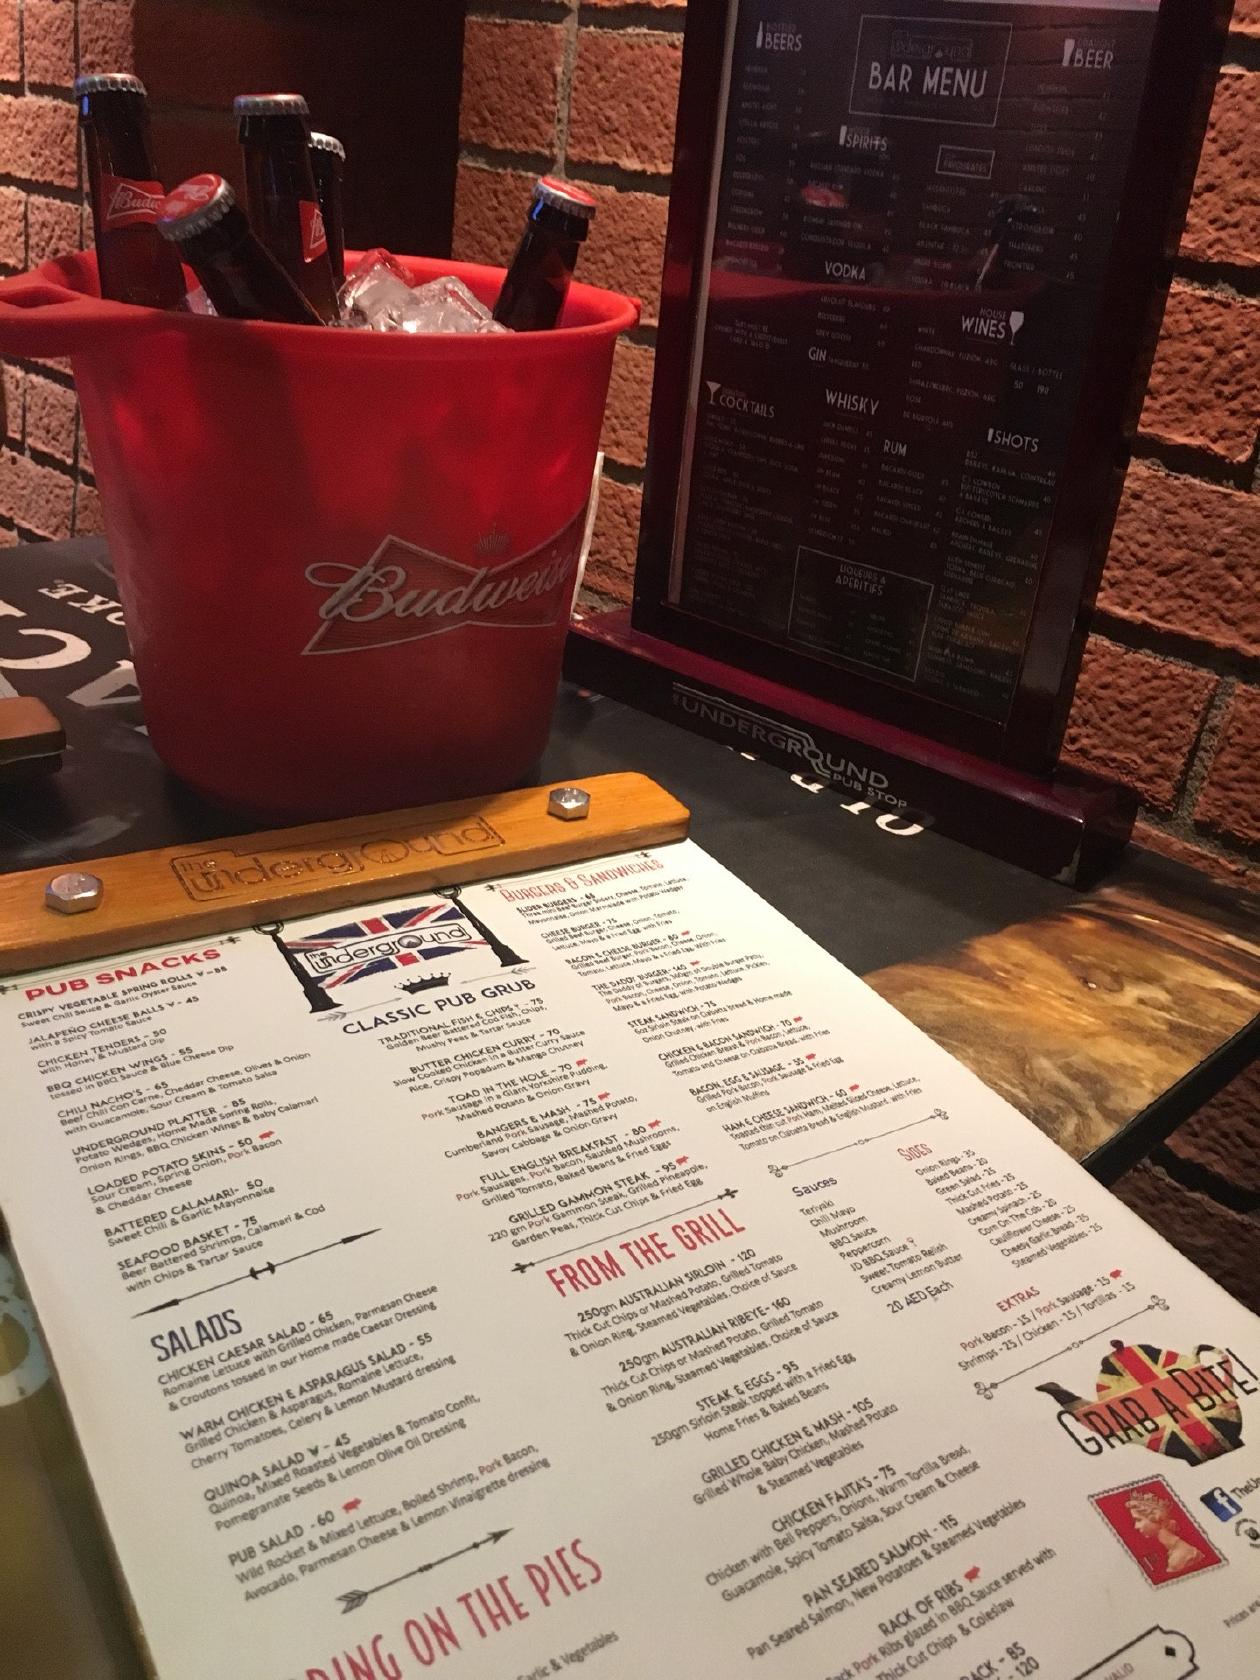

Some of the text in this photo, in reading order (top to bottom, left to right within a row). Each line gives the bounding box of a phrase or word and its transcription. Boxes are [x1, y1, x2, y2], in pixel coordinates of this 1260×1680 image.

[765, 32, 802, 52] BEERS
[1073, 48, 1113, 70] BEER
[869, 62, 988, 98] BAR MENU
[844, 134, 888, 152] SPIRITS
[825, 261, 867, 281] VODKA
[961, 316, 1006, 339] WINES
[808, 347, 827, 363] GIN
[719, 395, 776, 419] COCKTAILS
[826, 389, 880, 416] WHISKY
[884, 439, 907, 457] RUM
[995, 430, 1039, 453] SHOTS
[833, 774, 907, 808] PUB STOP
[499, 882, 566, 902] BURGERS
[577, 860, 664, 886] SANDWICHES
[25, 949, 221, 1001] PUB SNACKS
[89, 1014, 130, 1029] CHEESE
[133, 1005, 164, 1018] BALLS
[343, 980, 535, 1034] CLASSIC PUB GRUB
[627, 1017, 655, 1028] STEAK
[655, 1005, 699, 1020] SANDWICH
[38, 1028, 167, 1067] CHICKEN TENDERS 50
[409, 1028, 560, 1074] BUTTER CHICKEN CURRY 70
[46, 1081, 71, 1092] BBQ
[75, 1066, 126, 1084] CHICKEN
[129, 1054, 168, 1069] WINGS
[154, 1081, 168, 1090] 65
[448, 1063, 572, 1103] TOAD IN THE HOLE 70
[72, 1098, 246, 1155] UNDERGROUND PLATTER 85
[476, 1118, 528, 1138] BANGERS
[539, 1105, 571, 1120] MASH
[582, 1098, 597, 1107] 75
[722, 1121, 745, 1132] HAM
[752, 1109, 785, 1124] CHEESE
[783, 1095, 829, 1114] SANDWICH
[835, 1089, 847, 1097] 60
[87, 1138, 253, 1195] LOADED POTATO SKINS 50
[480, 1126, 646, 1184] FULL ENGLISH BREAKFAST 80
[509, 1162, 676, 1223] GRILLED GAMMON STEAK 95
[792, 1177, 837, 1197] Sauces
[800, 1200, 835, 1215] Teriyaki
[104, 1211, 167, 1237] BATTERED
[246, 1179, 263, 1190] 50
[819, 1216, 868, 1237] Mushroom
[117, 1216, 257, 1270] SEAFOOD BASKET 75
[546, 1208, 746, 1297] FROM THE GRILL
[839, 1236, 891, 1260] Peppercorn
[577, 1249, 756, 1323] 250gm AUSTRALIAN SIRLOIN 120
[886, 1280, 954, 1313] 20 AED Each
[996, 1286, 1040, 1312] EXTRAS
[150, 1309, 242, 1362] SALADS
[158, 1311, 333, 1385] CHICKEN CAESAR SALAD 65
[179, 1416, 225, 1440] WARM
[227, 1393, 284, 1422] CHICKEN
[299, 1360, 367, 1396] ASPARAGUS
[368, 1343, 406, 1366] SALAD
[417, 1333, 432, 1346] 55
[696, 1389, 734, 1411] STEAK
[744, 1371, 775, 1391] EGGS
[782, 1361, 799, 1374] 95
[701, 1455, 750, 1483] GRILLED
[751, 1431, 803, 1460] CHICKEN
[811, 1411, 846, 1432] MASH
[852, 1397, 873, 1413] 105
[1057, 1397, 1160, 1455] GRAB
[1151, 1386, 1189, 1421] A
[204, 1433, 350, 1501] QUINOA SALAD 45
[772, 1498, 827, 1532] CHICKEN
[878, 1465, 896, 1480] 75
[228, 1510, 334, 1567] PUB SALAD 60
[802, 1514, 958, 1607] PAN SEARED SALMON 115
[404, 1607, 462, 1666] ON
[456, 1575, 530, 1638] THE
[523, 1538, 602, 1607] PIES
[878, 1579, 963, 1637] RACK OF RIBS
